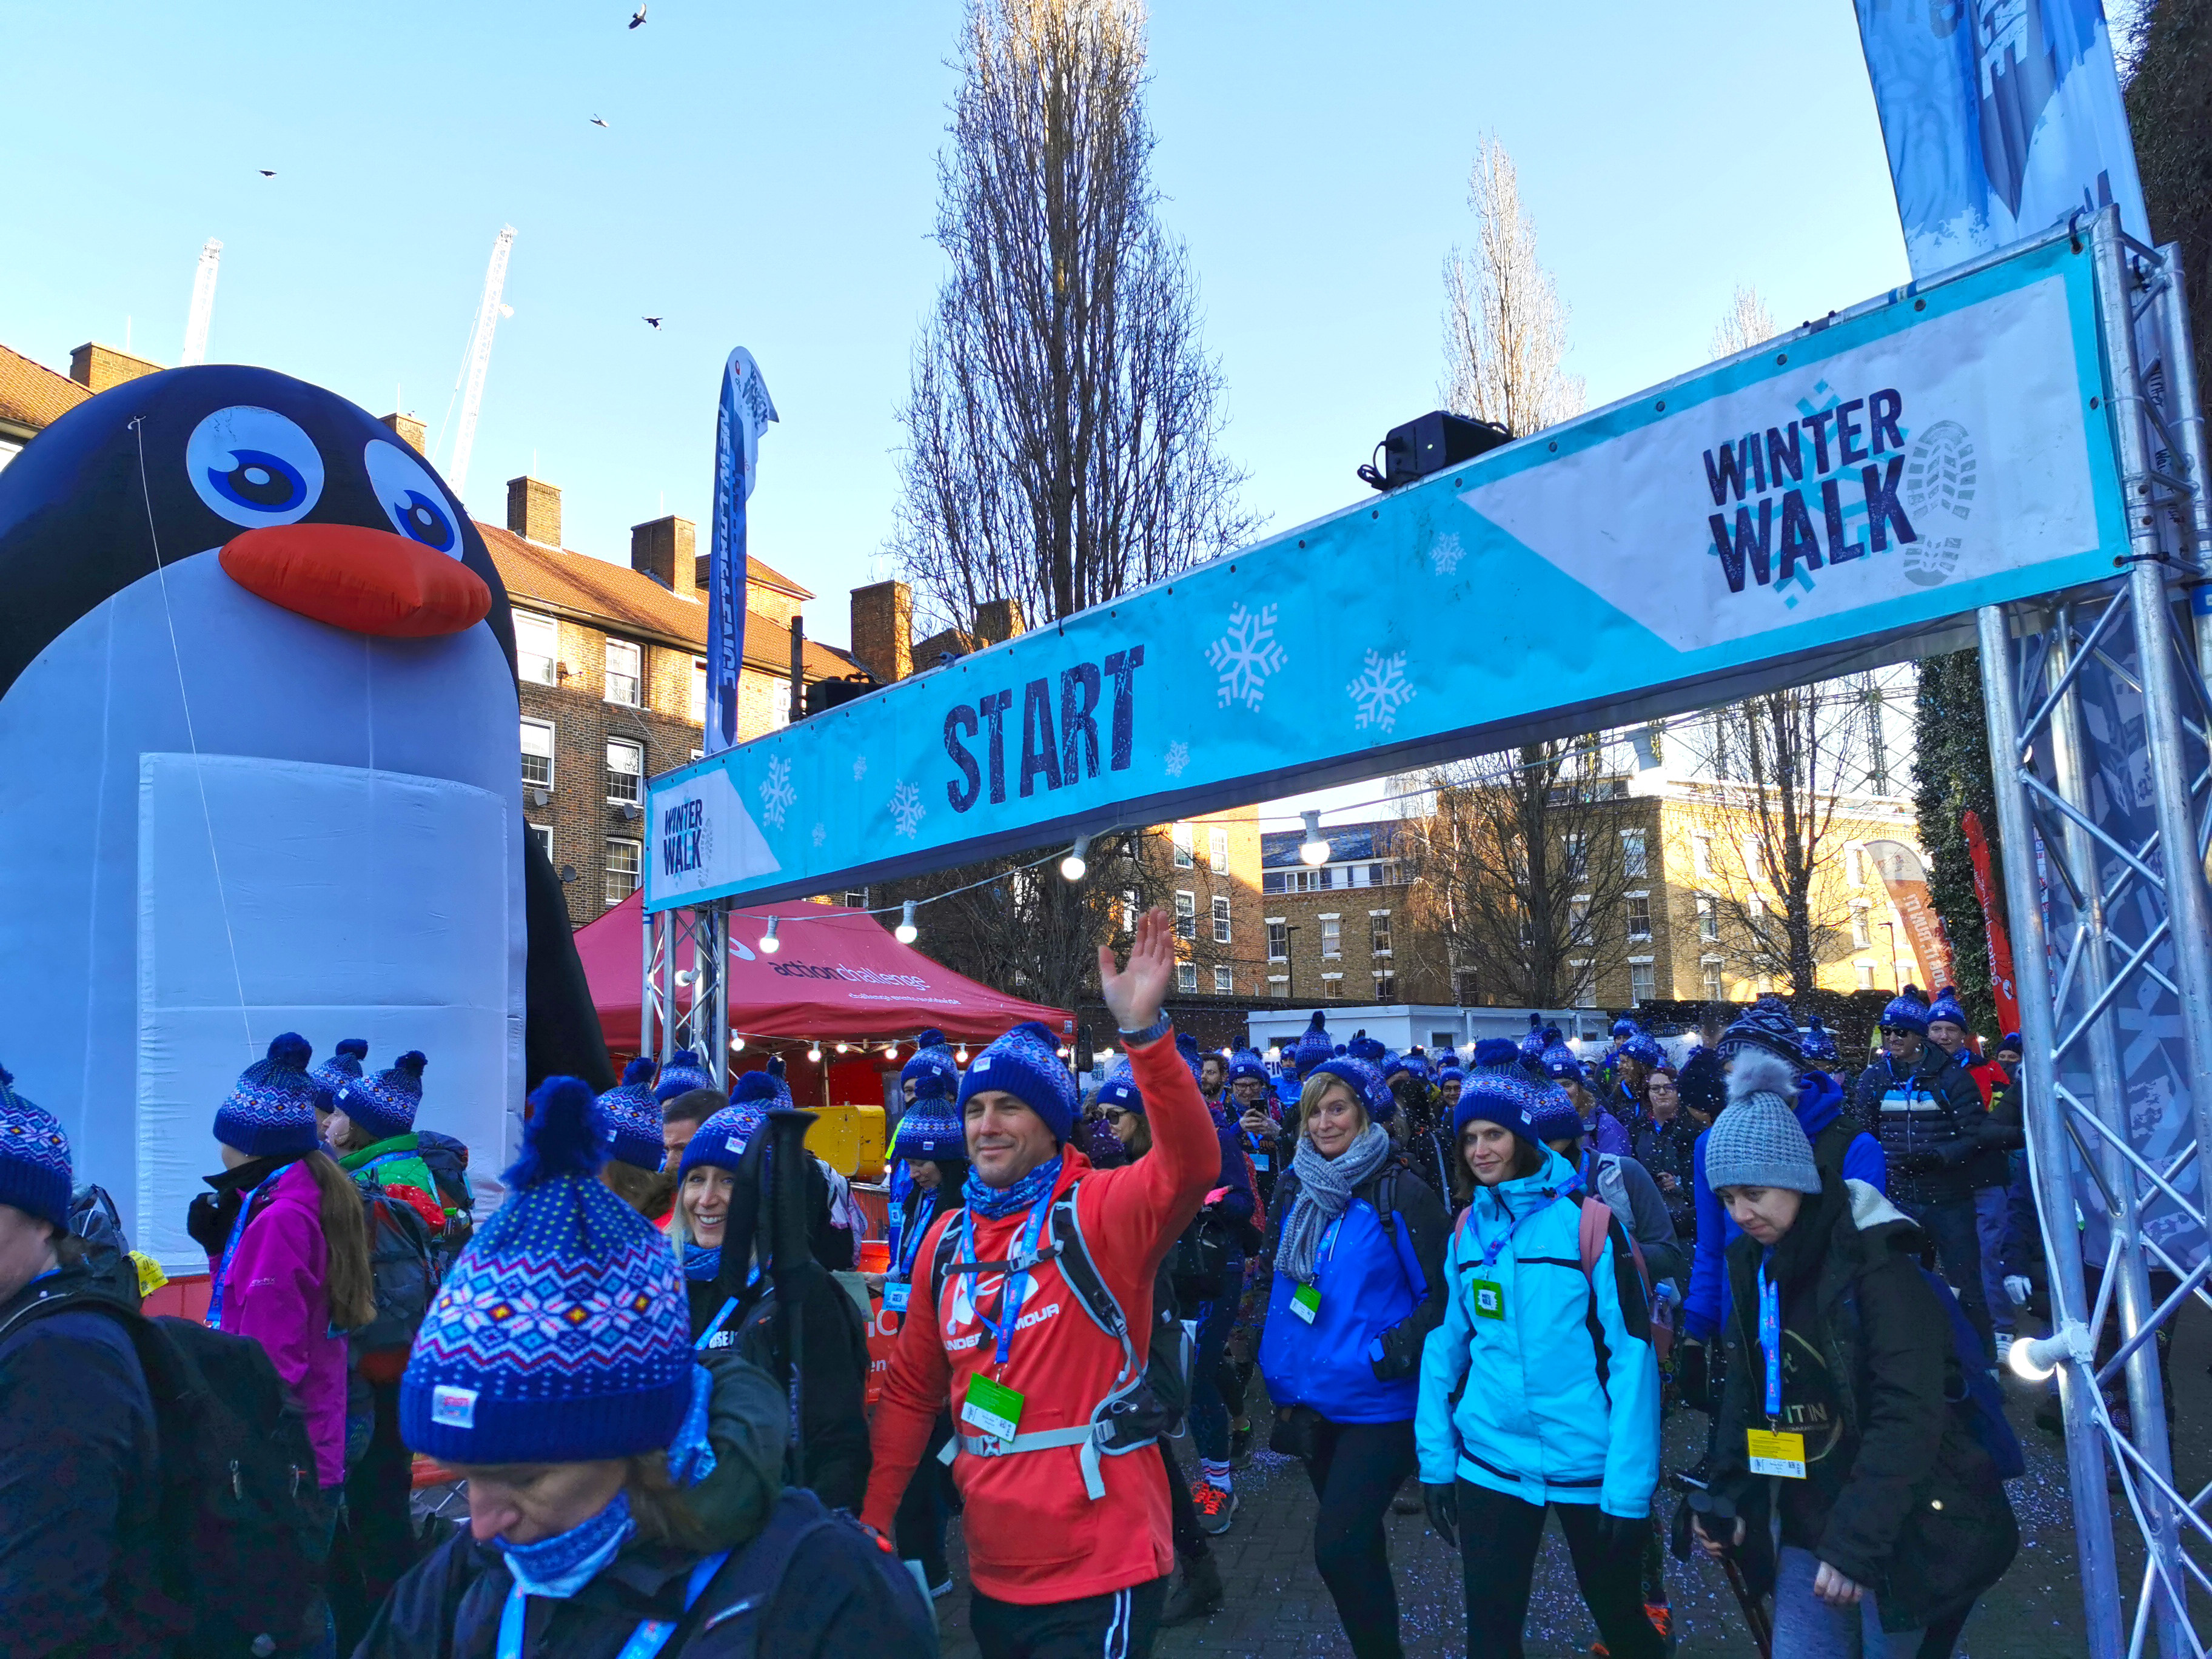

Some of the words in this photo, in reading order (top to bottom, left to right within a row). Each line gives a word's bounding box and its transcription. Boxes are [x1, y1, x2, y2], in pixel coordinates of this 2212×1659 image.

[1703, 388, 1905, 506] WINTER
[1708, 454, 1918, 593] WALK
[943, 644, 1145, 814] START
[663, 829, 702, 876] WALK
[665, 799, 703, 836] WINTER
[768, 960, 931, 991] actionchallenge
